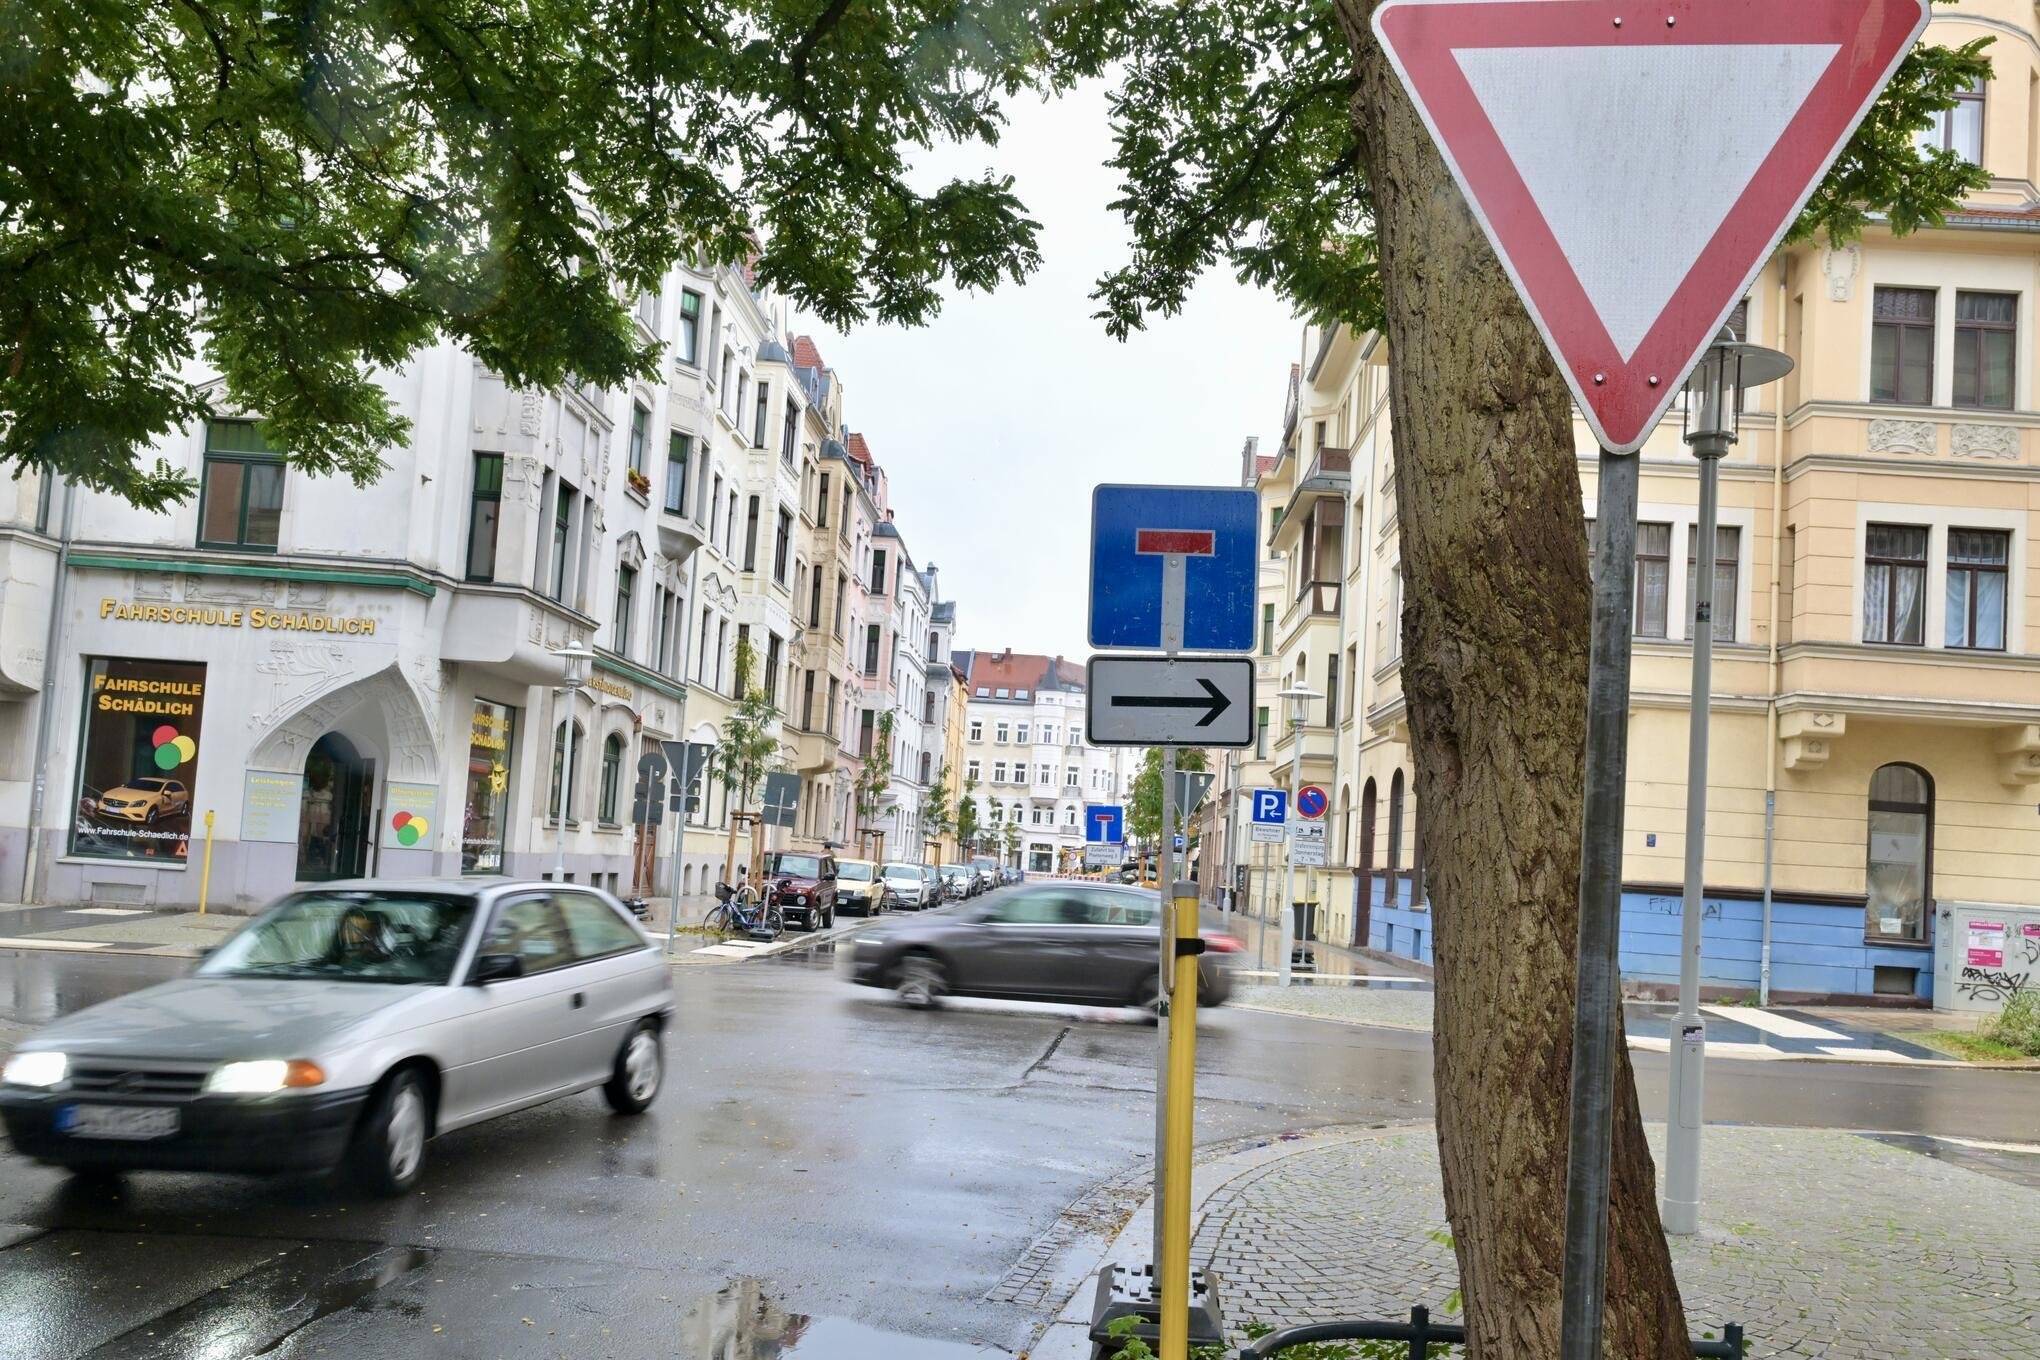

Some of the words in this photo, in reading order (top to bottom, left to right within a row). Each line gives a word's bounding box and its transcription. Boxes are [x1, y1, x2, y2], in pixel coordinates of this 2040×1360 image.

[100, 598, 243, 627] FAHRSCHULE
[249, 608, 375, 636] SCHÄDLICH
[94, 674, 202, 696] FAHRSCHULE
[98, 695, 193, 715] SCHÄDLICH
[1260, 794, 1279, 819] P
